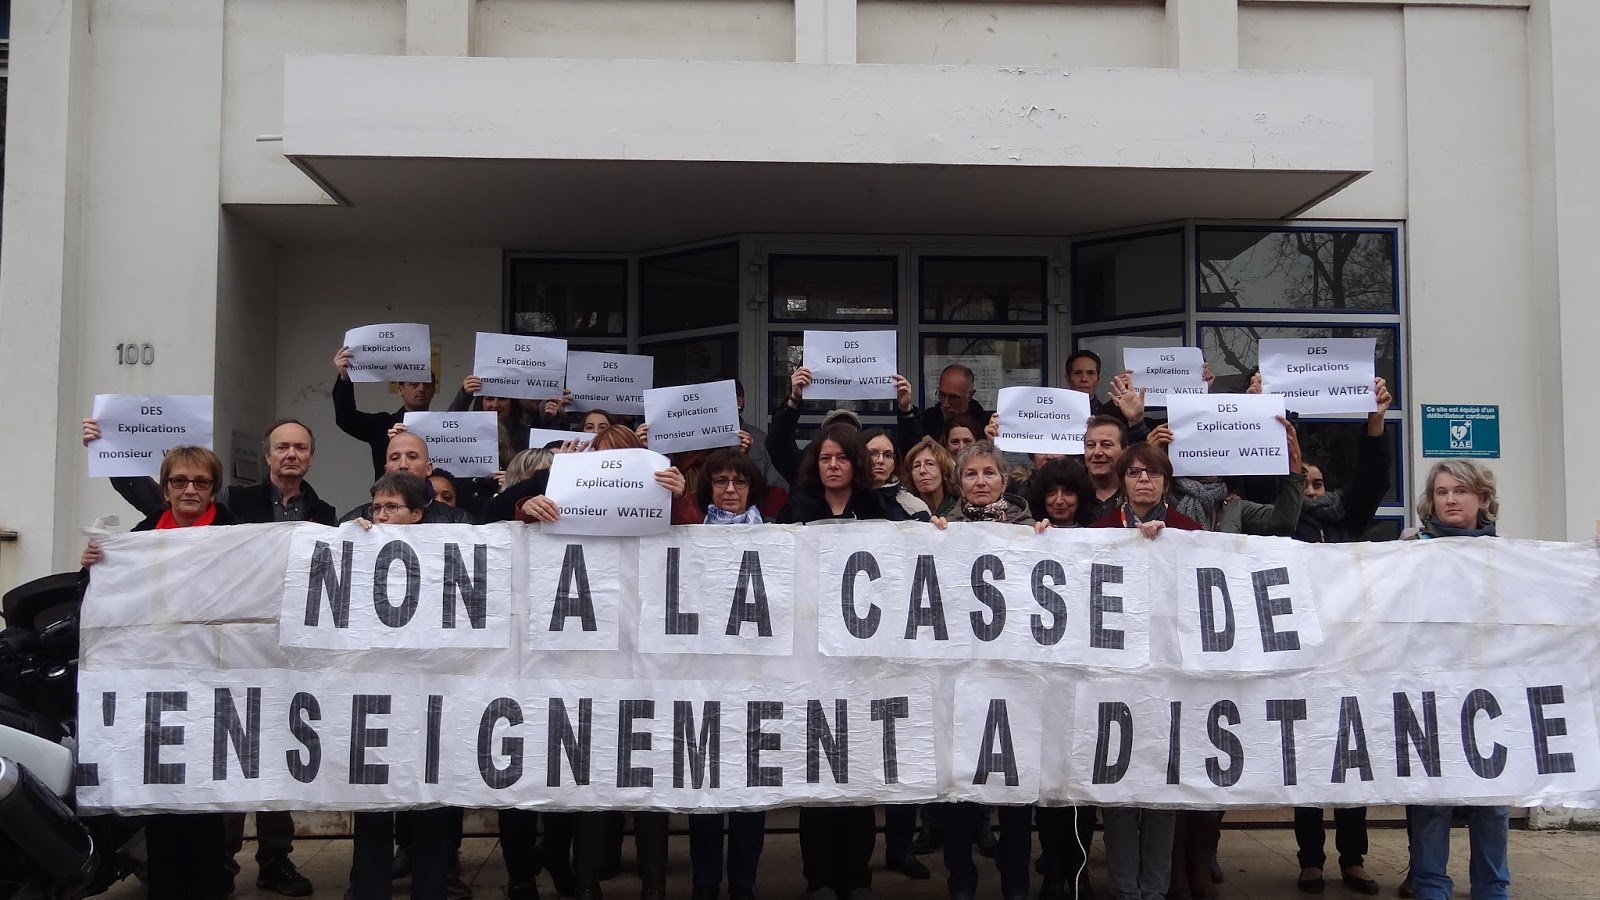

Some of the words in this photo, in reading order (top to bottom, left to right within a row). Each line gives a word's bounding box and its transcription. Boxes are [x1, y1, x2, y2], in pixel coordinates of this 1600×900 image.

[362, 344, 412, 353] Explications
[1307, 346, 1328, 355] DES
[116, 343, 155, 365] 100
[497, 356, 546, 367] Explications
[603, 361, 618, 369] DES
[826, 355, 876, 365] Explications
[1146, 366, 1190, 375] Explications
[1287, 362, 1349, 374] Explications
[527, 378, 559, 387] WATIEZ
[587, 374, 634, 383] Explications
[810, 377, 852, 385] monsieur
[859, 376, 892, 385] WATIEZ
[1328, 386, 1369, 396] WATIEZ
[616, 394, 644, 402] WATIE
[683, 393, 700, 402] DES
[141, 406, 163, 415] DES
[667, 405, 718, 419] Explications
[1218, 403, 1238, 413] DES
[1018, 410, 1071, 420] Explications
[118, 424, 186, 434] Explications
[1196, 421, 1261, 432] Explications
[655, 429, 695, 441] monsieur
[702, 424, 735, 435] WATIEZ
[426, 435, 477, 444] Explications
[99, 449, 153, 458] monsieur
[1178, 446, 1230, 458] monsieur
[1238, 447, 1281, 456] WATIEZ
[601, 460, 623, 469] DES
[576, 478, 644, 489] Explications
[618, 507, 663, 518] WATIEZ
[304, 540, 487, 629] NON
[548, 544, 598, 632] A
[664, 547, 773, 637] LA
[841, 550, 1125, 650] CASSE
[1196, 566, 1300, 653] DE
[972, 698, 1020, 786] A
[1092, 685, 1576, 788] DISTANCE
